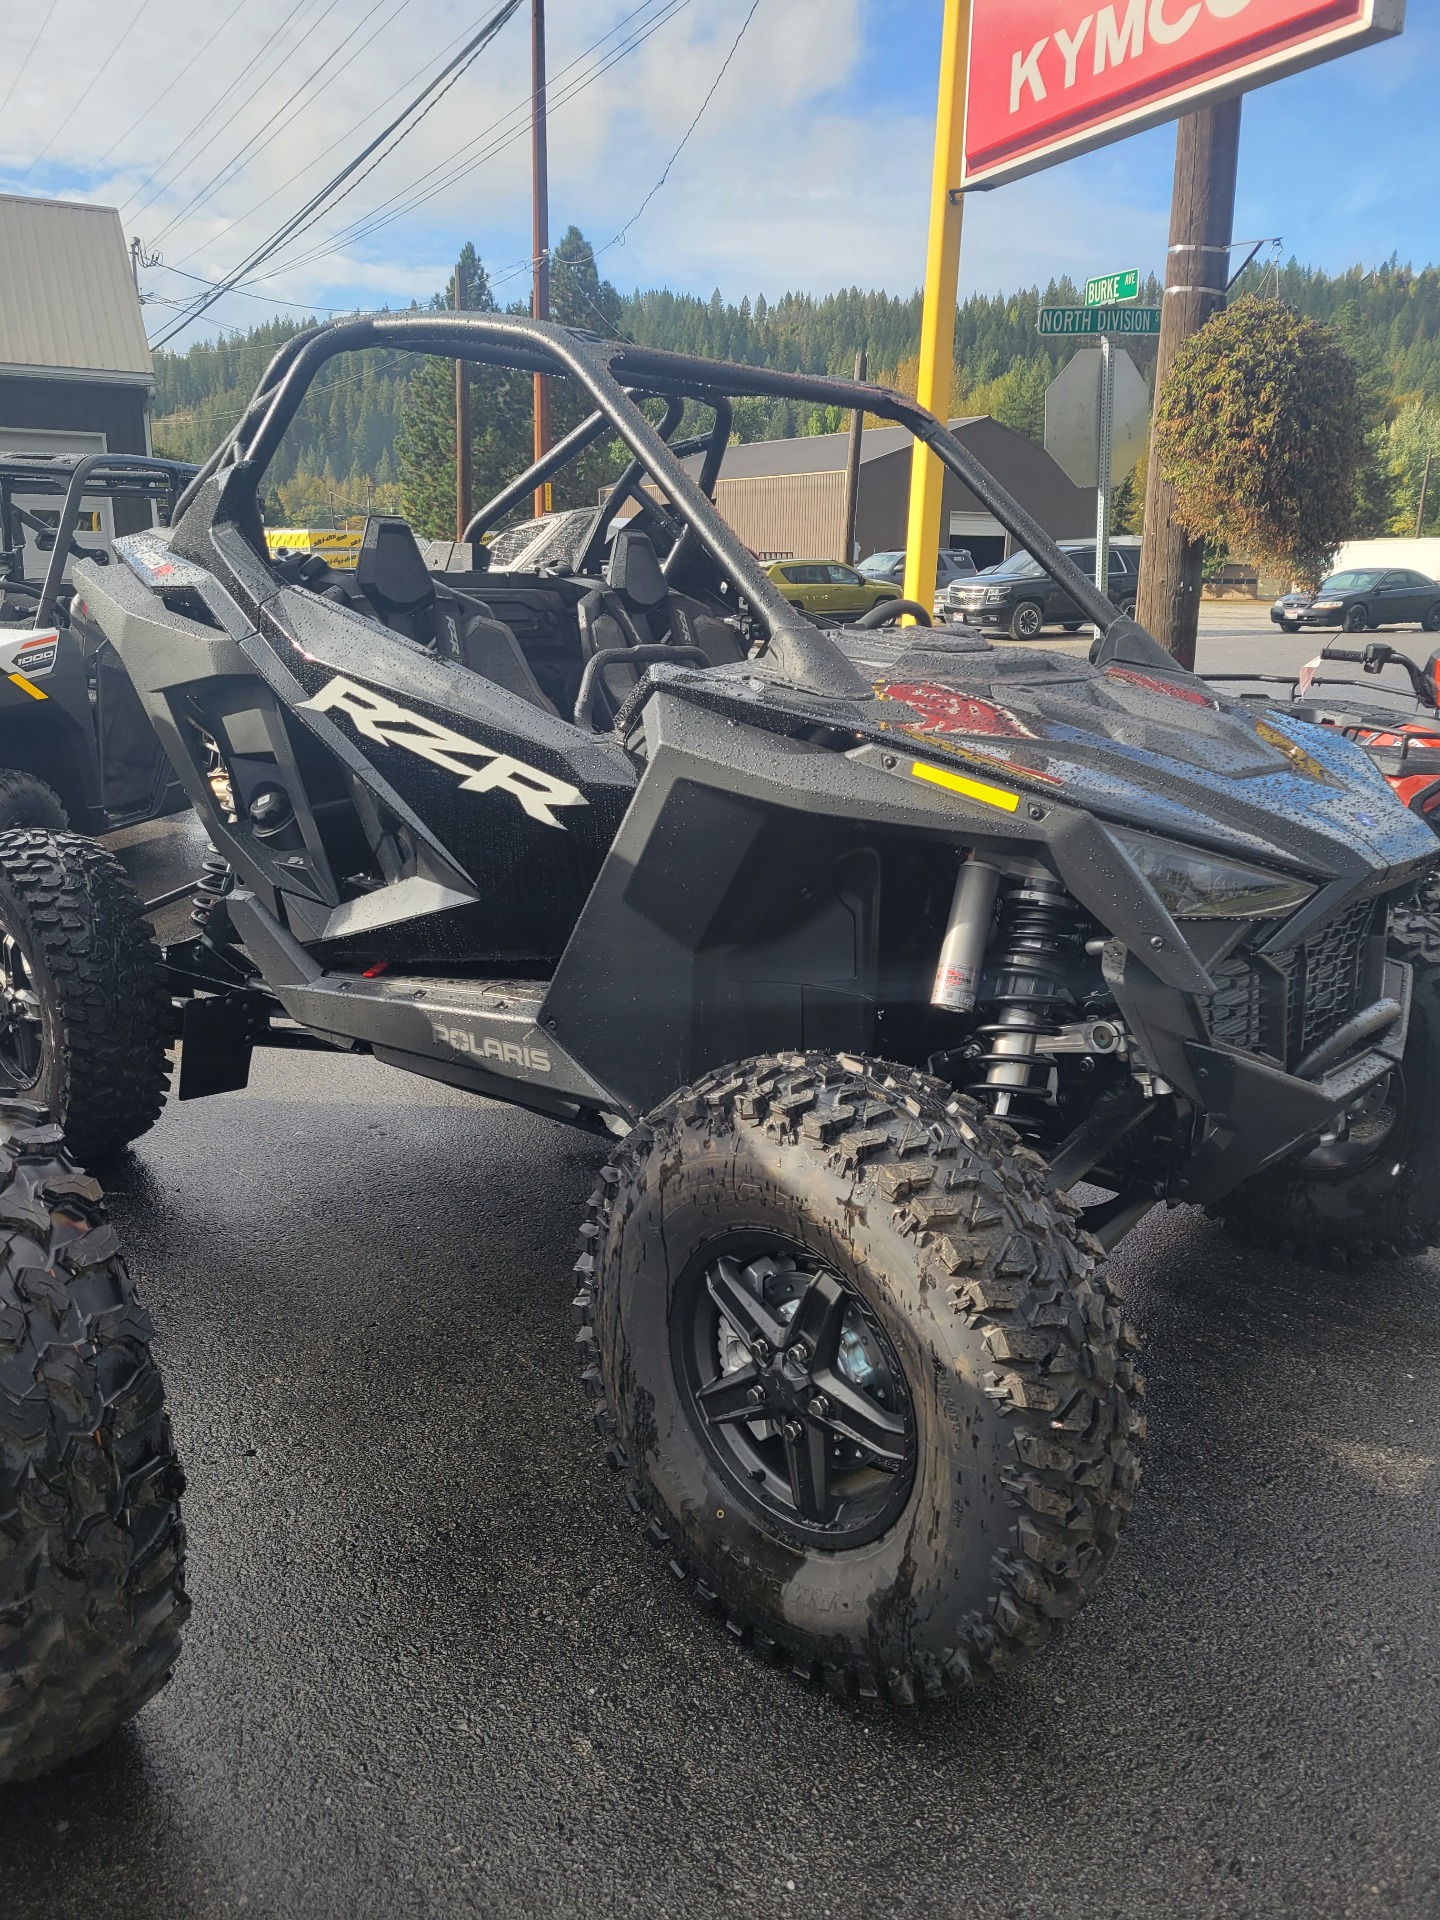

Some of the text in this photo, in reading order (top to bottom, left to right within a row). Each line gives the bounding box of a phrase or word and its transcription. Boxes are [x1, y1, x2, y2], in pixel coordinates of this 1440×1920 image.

[1009, 0, 1253, 114] KYMC
[1088, 272, 1136, 304] BURKE AVE
[1041, 310, 1092, 332] NORTH
[1097, 310, 1151, 331] DIVISION
[445, 615, 460, 655] RZR
[17, 650, 54, 666] 1000
[294, 675, 590, 831] RZR
[430, 1021, 552, 1072] POLARIS
